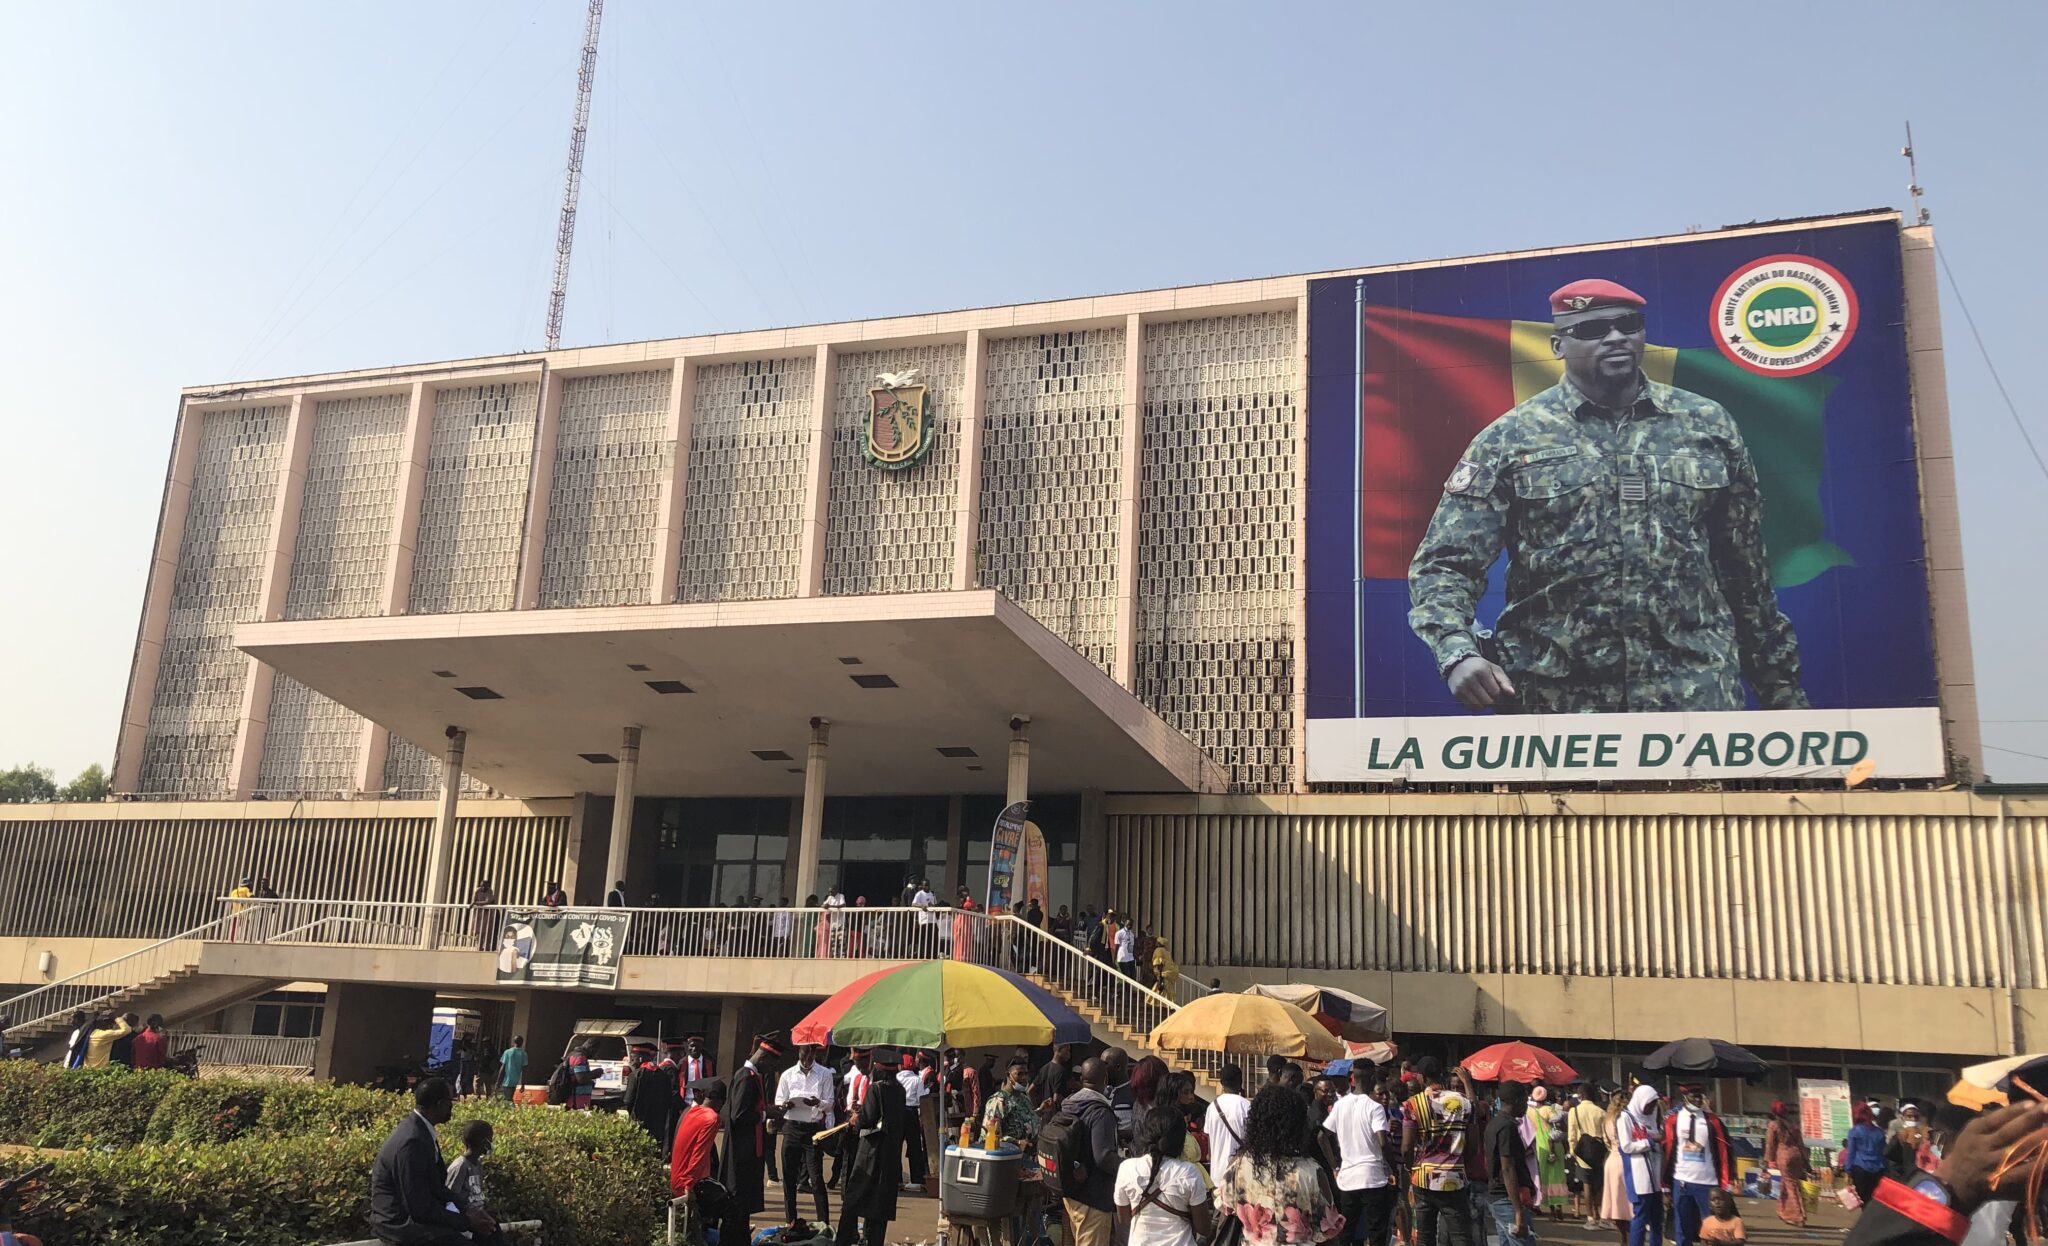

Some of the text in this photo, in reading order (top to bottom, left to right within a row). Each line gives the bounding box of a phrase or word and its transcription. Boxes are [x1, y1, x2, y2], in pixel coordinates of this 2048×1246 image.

[1734, 271, 1771, 299] NATIONAL
[1772, 269, 1785, 278] DU
[1786, 269, 1841, 315] RASSEMBLEMENT
[1747, 306, 1818, 329] CNRD
[1736, 345, 1758, 362] POUR
[1759, 356, 1769, 365] LE
[1367, 730, 1869, 770] LA GUINEE D'ABORD
[599, 914, 626, 923] COVID-19
